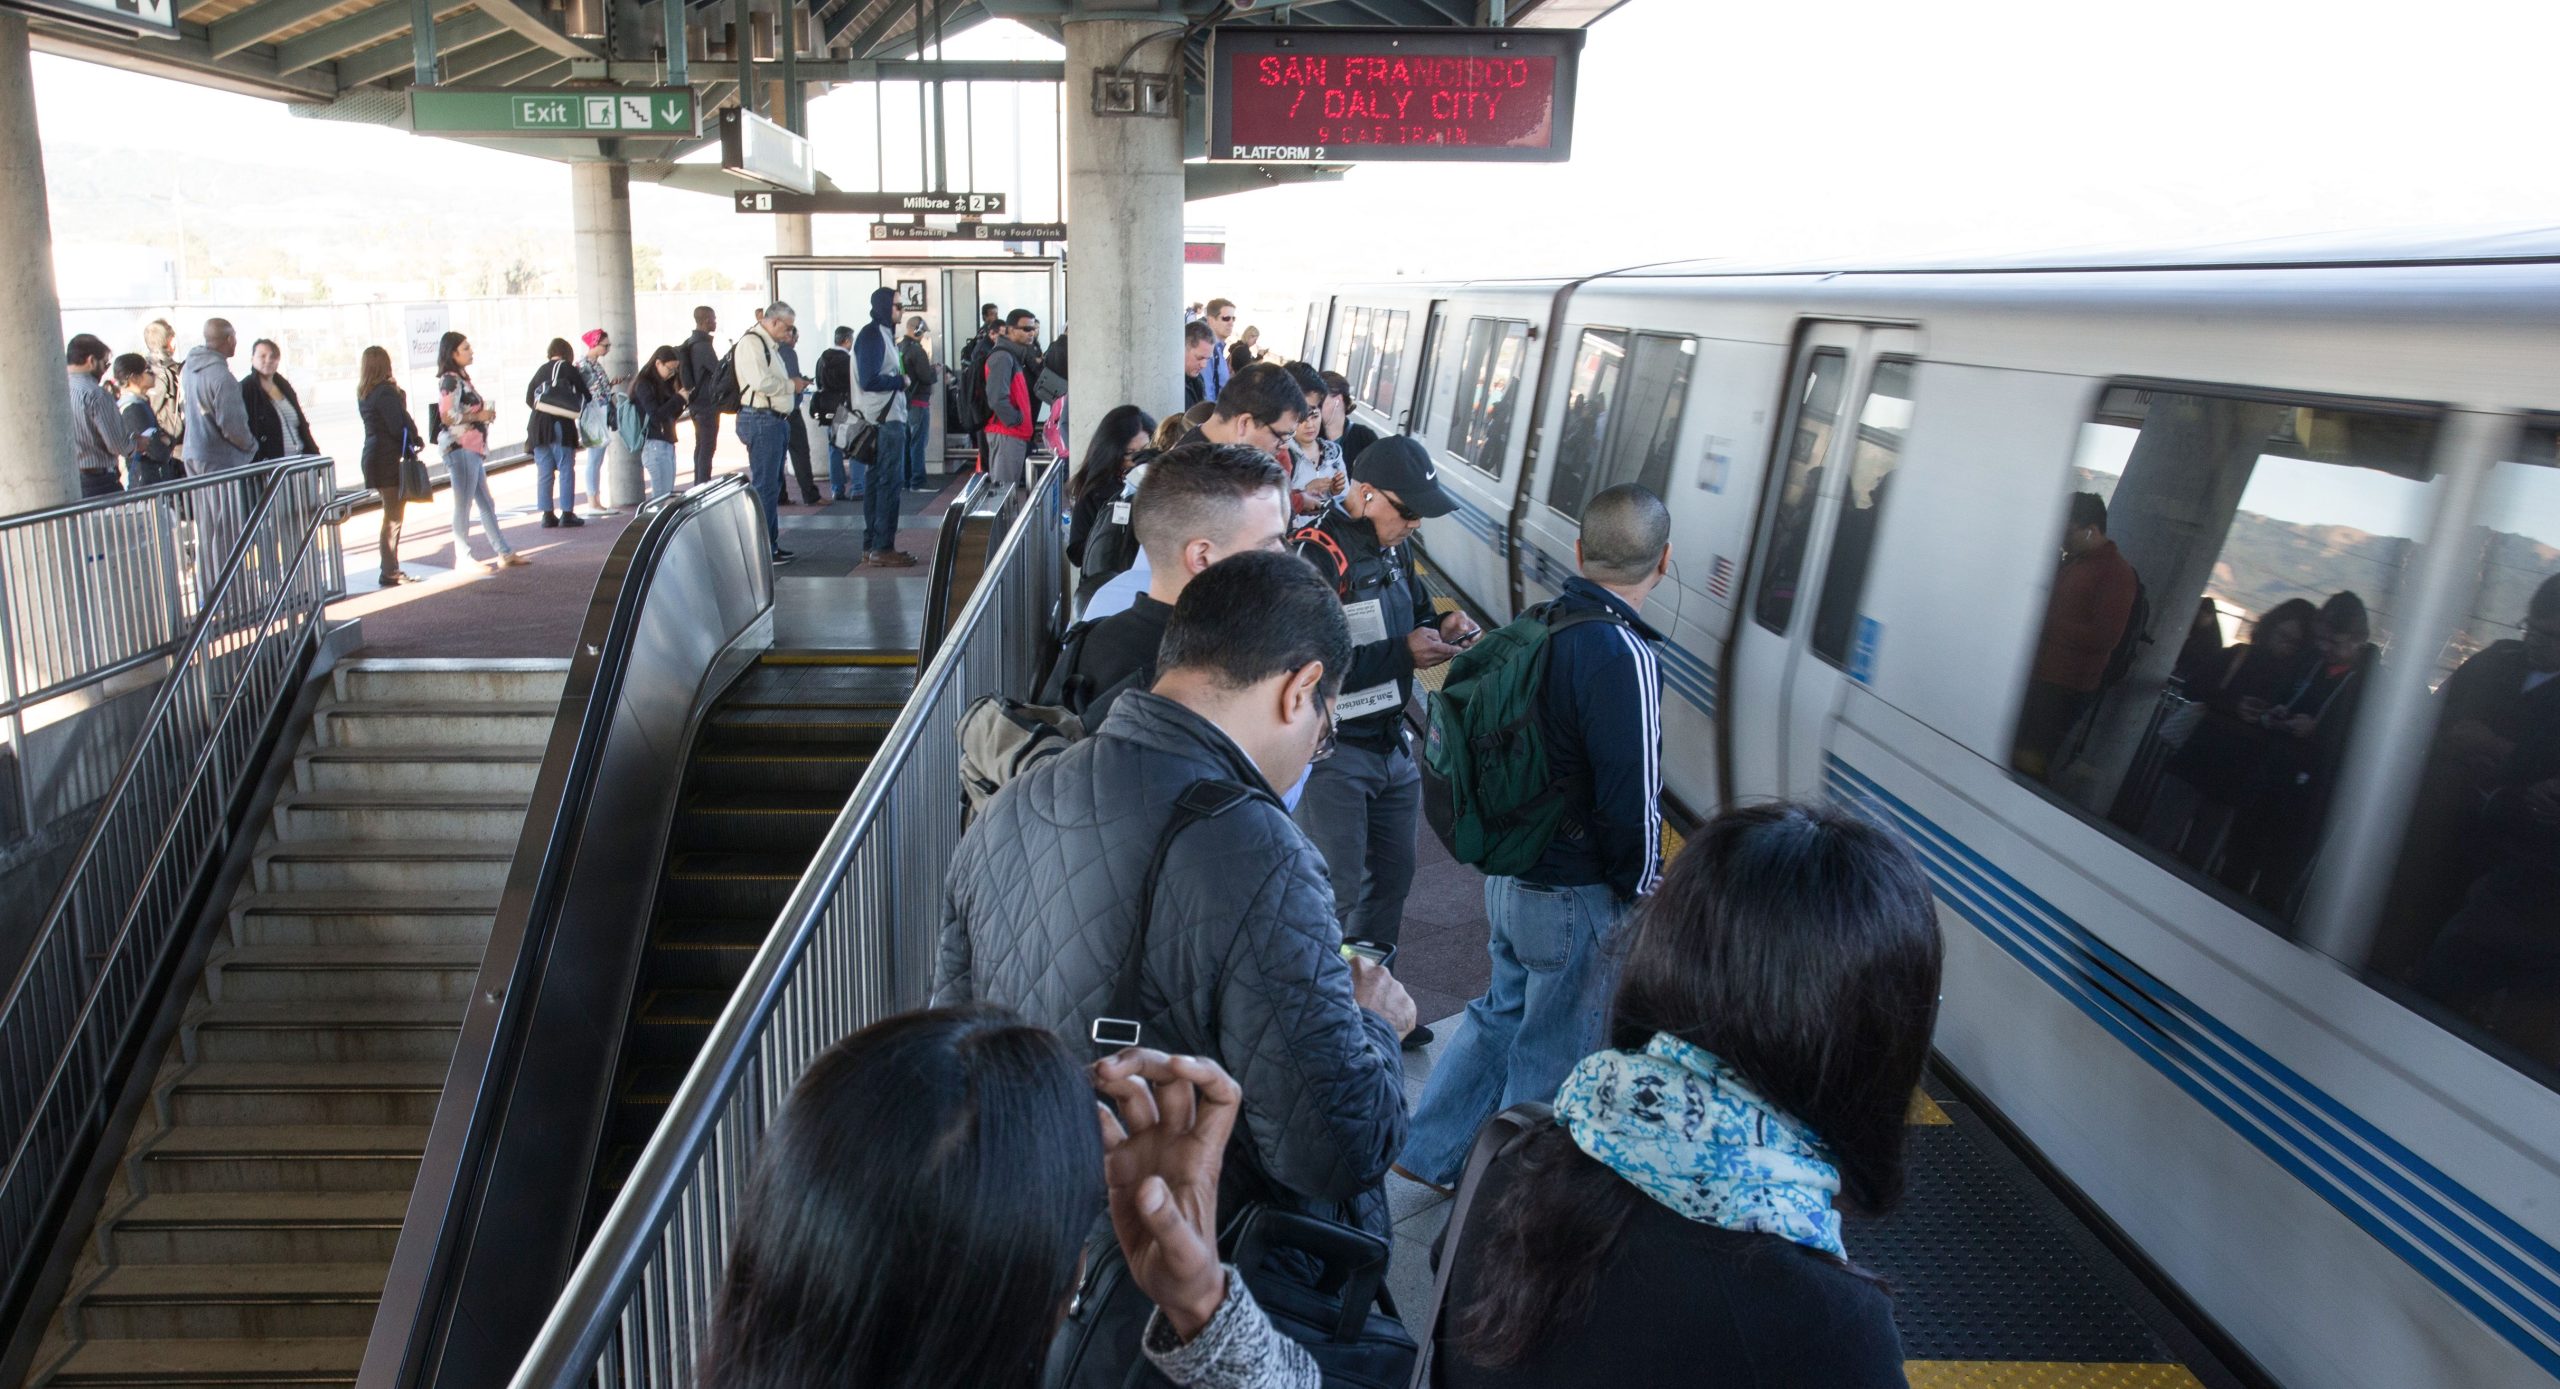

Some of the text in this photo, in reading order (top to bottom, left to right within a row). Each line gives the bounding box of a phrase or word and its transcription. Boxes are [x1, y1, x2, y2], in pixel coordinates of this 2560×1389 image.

[1260, 56, 1529, 88] SAN FRANCISCO
[523, 102, 567, 123] Exit
[1289, 89, 1503, 120] / DALY CITY
[1318, 126, 1469, 145] 9 CAR TRAIN
[1232, 145, 1326, 160] PLATFORM 2
[760, 197, 768, 207] 1
[903, 195, 982, 209] Millbrae 2
[892, 228, 948, 239] No Smoking
[993, 228, 1061, 237] No Food/Drink
[1336, 691, 1394, 711] San Francisco
